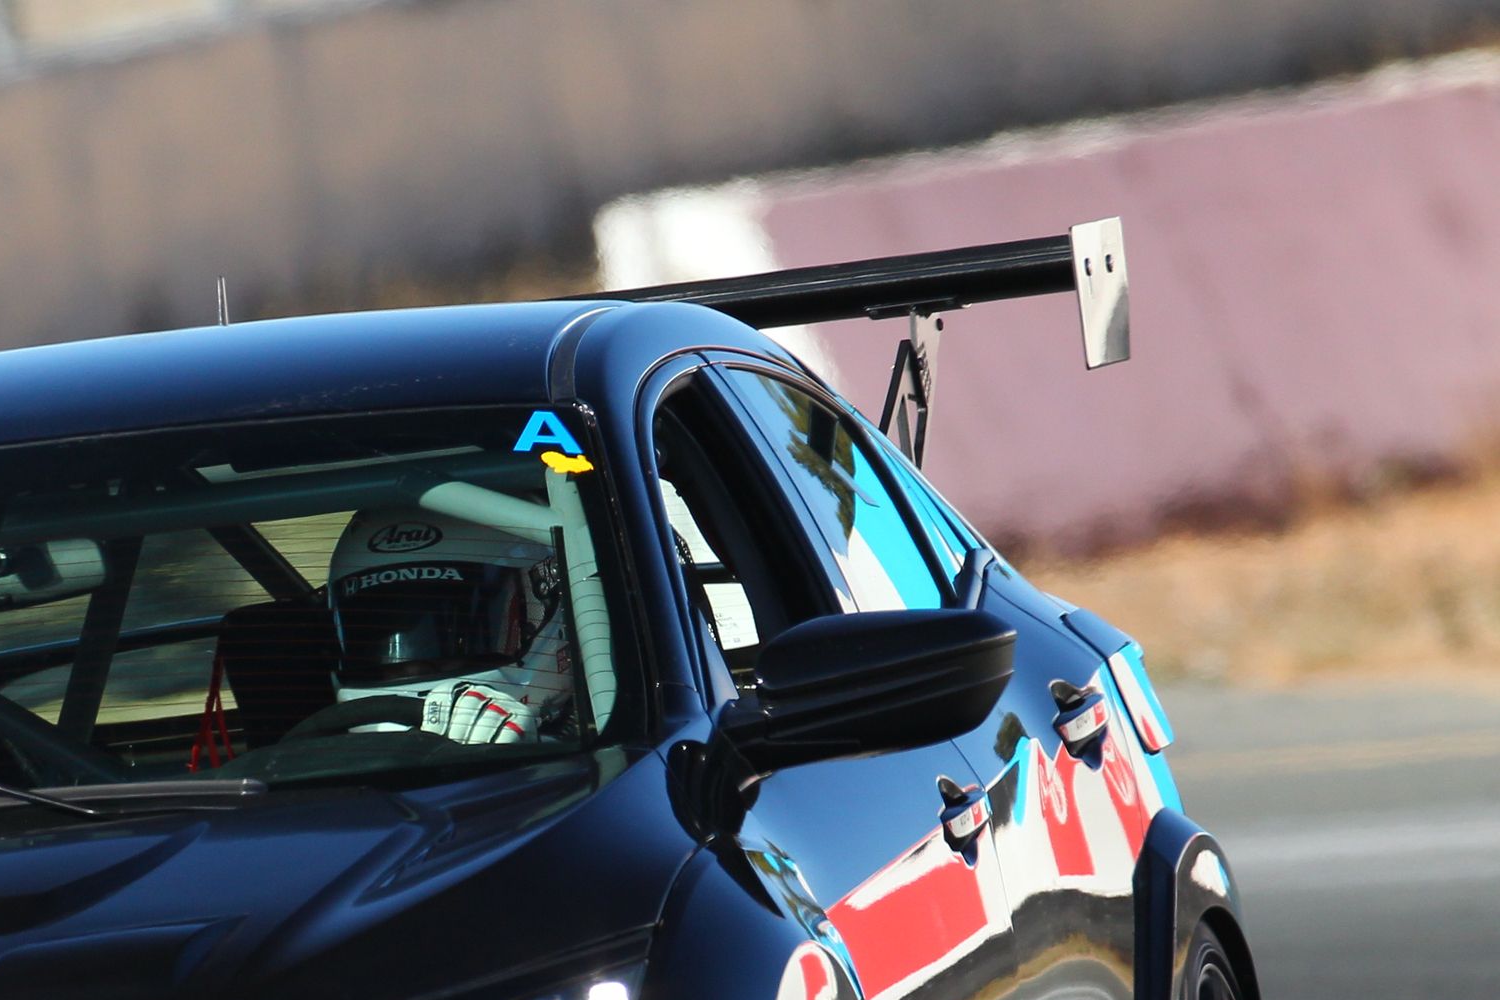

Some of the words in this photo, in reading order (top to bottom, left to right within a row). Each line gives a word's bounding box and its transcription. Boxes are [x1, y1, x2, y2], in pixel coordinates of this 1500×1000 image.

[513, 410, 583, 454] A
[377, 524, 434, 545] Arai
[360, 567, 464, 589] HONDA
[429, 701, 439, 724] OMP
